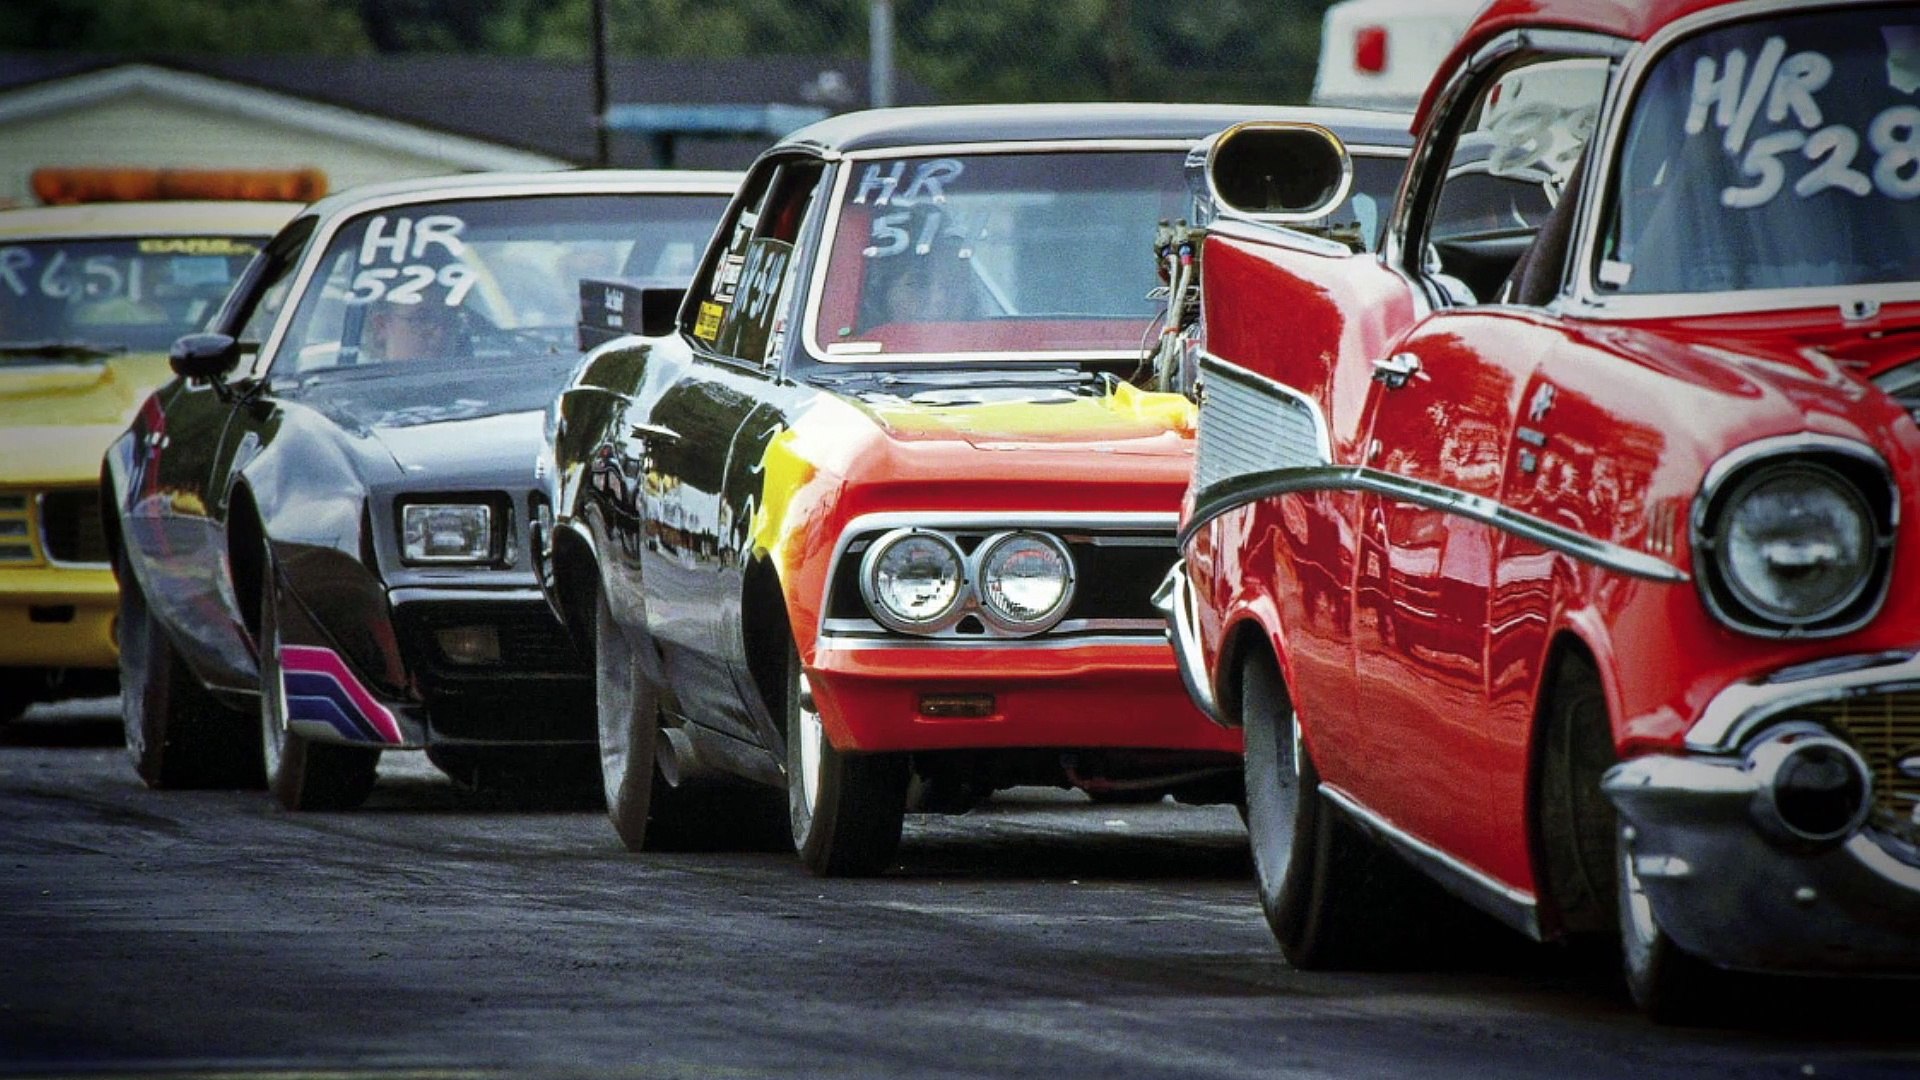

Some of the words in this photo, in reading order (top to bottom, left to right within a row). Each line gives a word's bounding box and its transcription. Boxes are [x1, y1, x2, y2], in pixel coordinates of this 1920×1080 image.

[1685, 36, 1833, 153] H/R
[853, 159, 965, 205] HR
[1721, 105, 1920, 208] 528
[360, 215, 465, 266] HR
[40, 250, 142, 303] 651
[344, 263, 480, 306] 529
